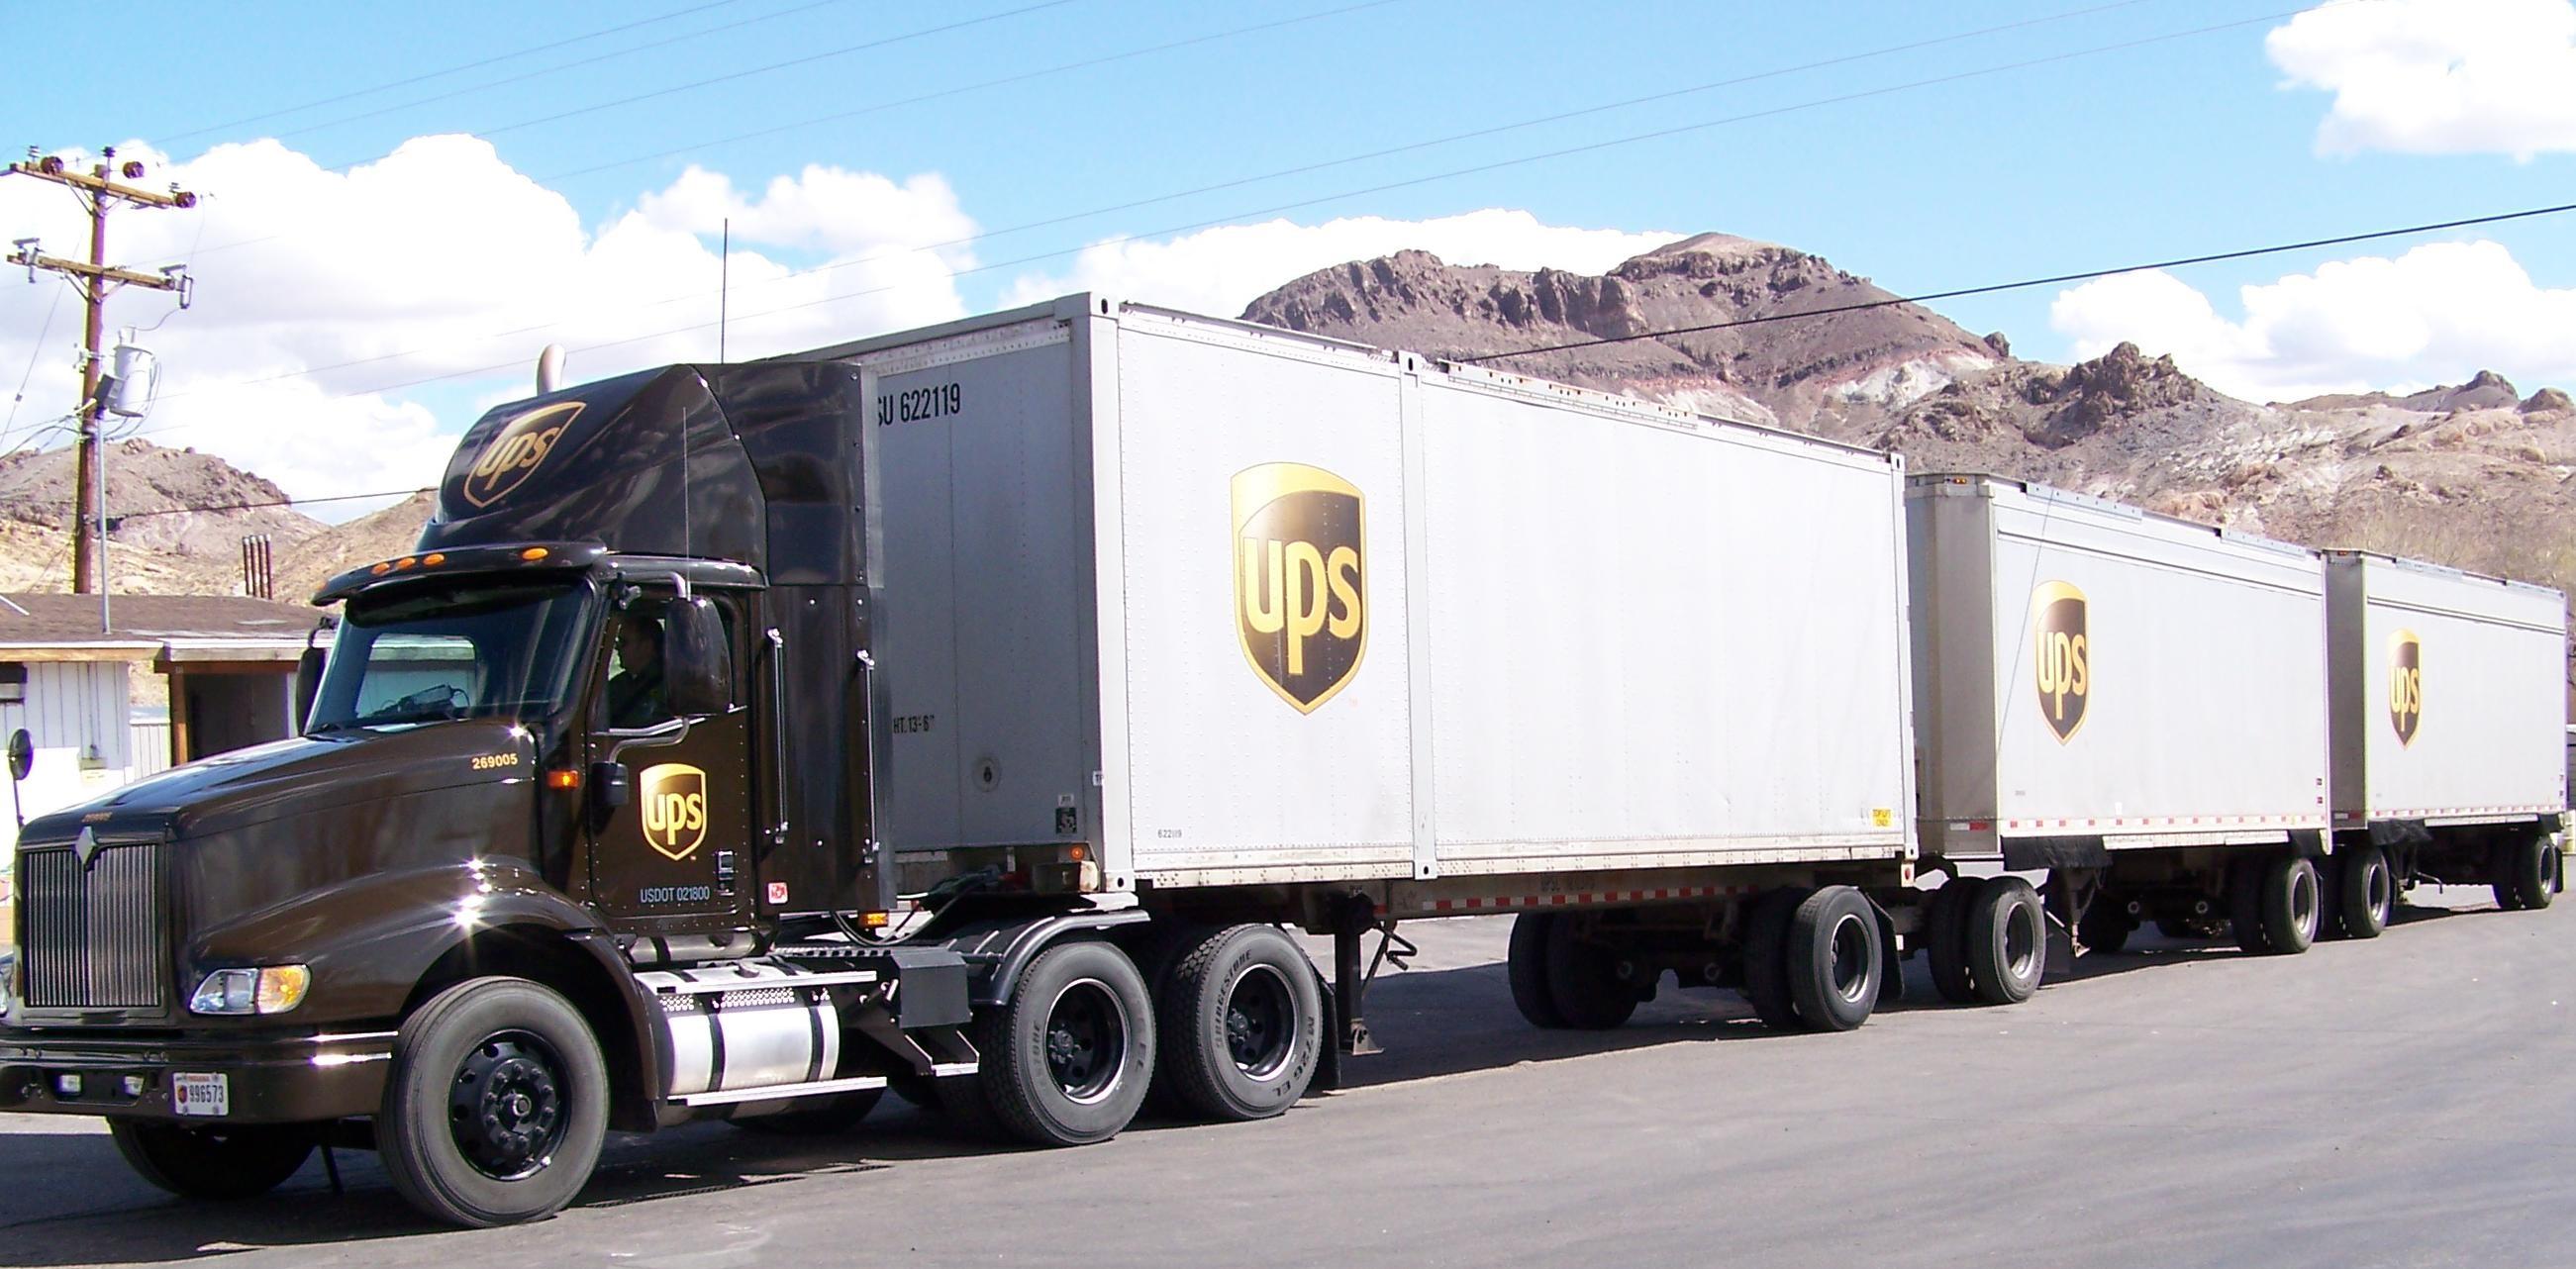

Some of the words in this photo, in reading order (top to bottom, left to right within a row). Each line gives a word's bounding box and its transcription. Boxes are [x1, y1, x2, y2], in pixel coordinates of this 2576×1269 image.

[900, 382, 960, 424] 622119
[475, 426, 561, 492] ups
[1242, 537, 1362, 677] ups
[2036, 630, 2087, 721] ups
[2390, 665, 2421, 732] ups
[471, 752, 518, 770] 269005
[645, 792, 703, 845] ups
[640, 887, 675, 903] USDOT
[676, 885, 711, 901] 021800
[188, 1084, 224, 1104] 996573
